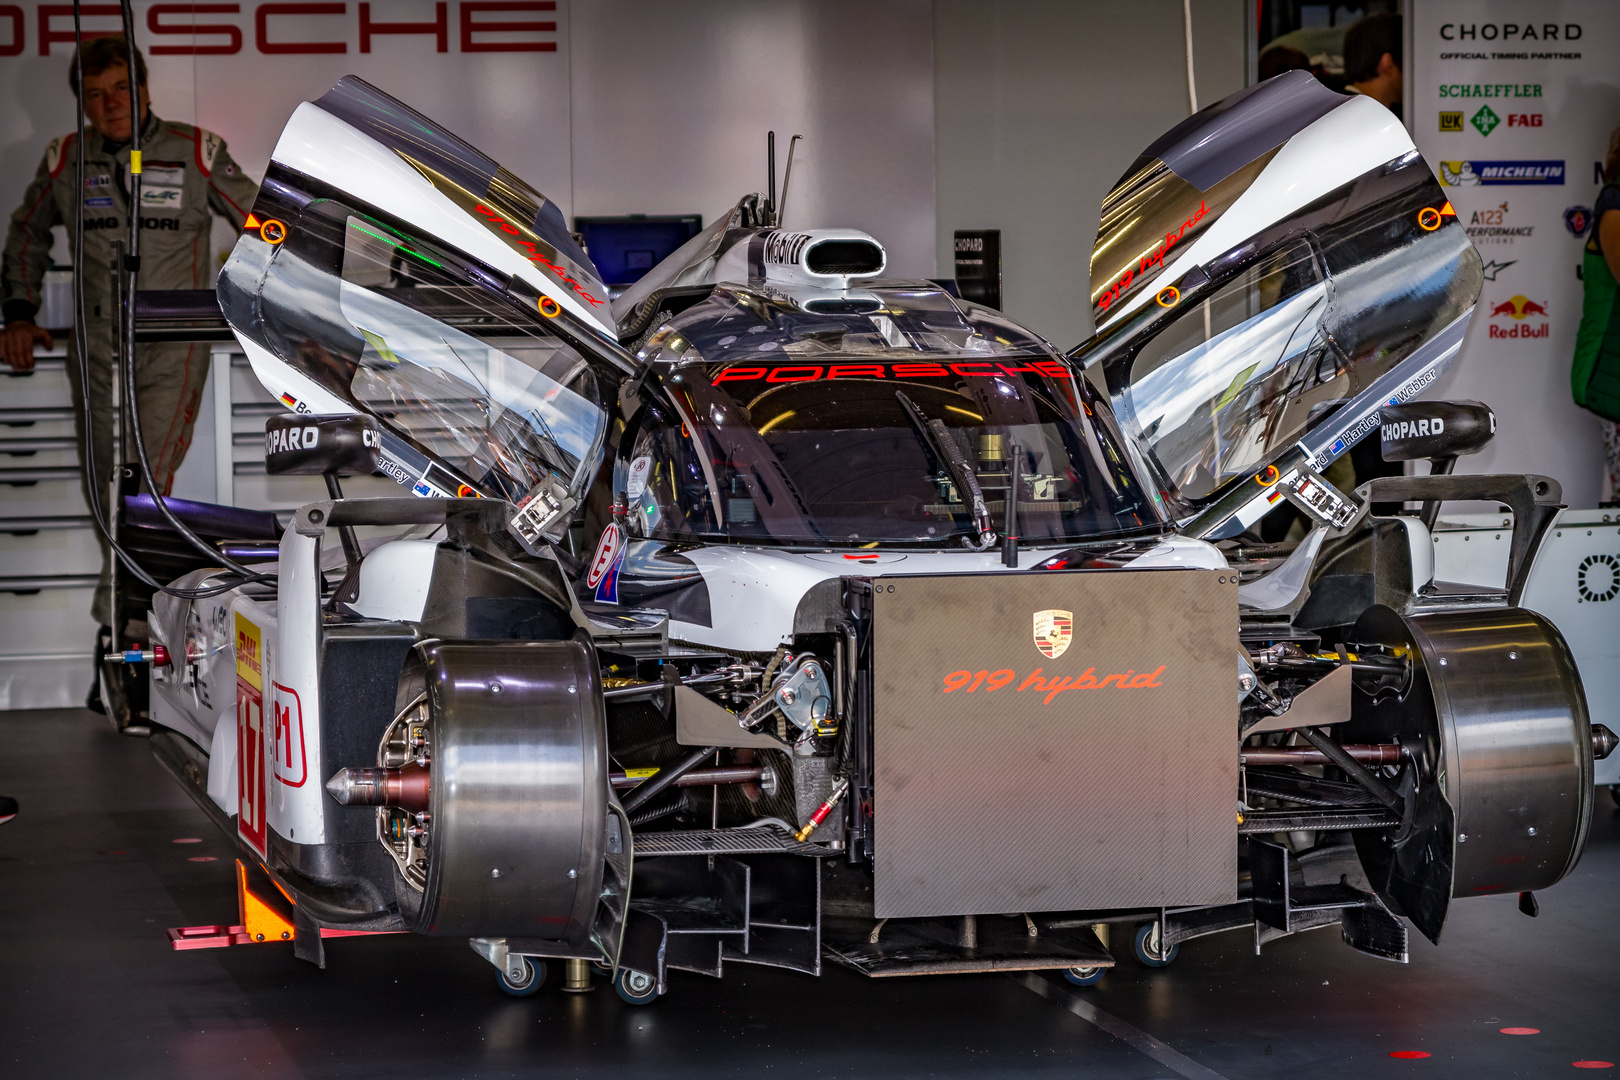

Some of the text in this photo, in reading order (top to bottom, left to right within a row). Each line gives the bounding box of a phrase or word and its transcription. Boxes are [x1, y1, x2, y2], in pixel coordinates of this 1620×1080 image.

[0, 1, 557, 57] RSCHE
[1440, 24, 1582, 41] CHOPARD
[1440, 52, 1582, 60] OFFICIAL TIMING PARTNER
[1439, 84, 1543, 98] SCHAEFFLER
[1507, 113, 1543, 128] FAG
[1481, 166, 1563, 178] MICHELIN
[1470, 209, 1504, 226] A123
[954, 237, 983, 252] CHOPARD
[1466, 226, 1535, 237] PERFORMANCE
[473, 204, 606, 309] 919 hybrid
[1098, 200, 1211, 311] 919 hybrid
[1489, 324, 1549, 339] Red Bull
[710, 361, 1078, 387] PORSCHE
[1396, 368, 1437, 404] Webber
[268, 426, 319, 456] OPARD
[1342, 410, 1382, 446] Hartley
[1381, 417, 1445, 443] CHOPARD
[377, 454, 411, 485] artley
[943, 665, 1168, 706] 919 hybrid
[239, 693, 260, 834] 17
